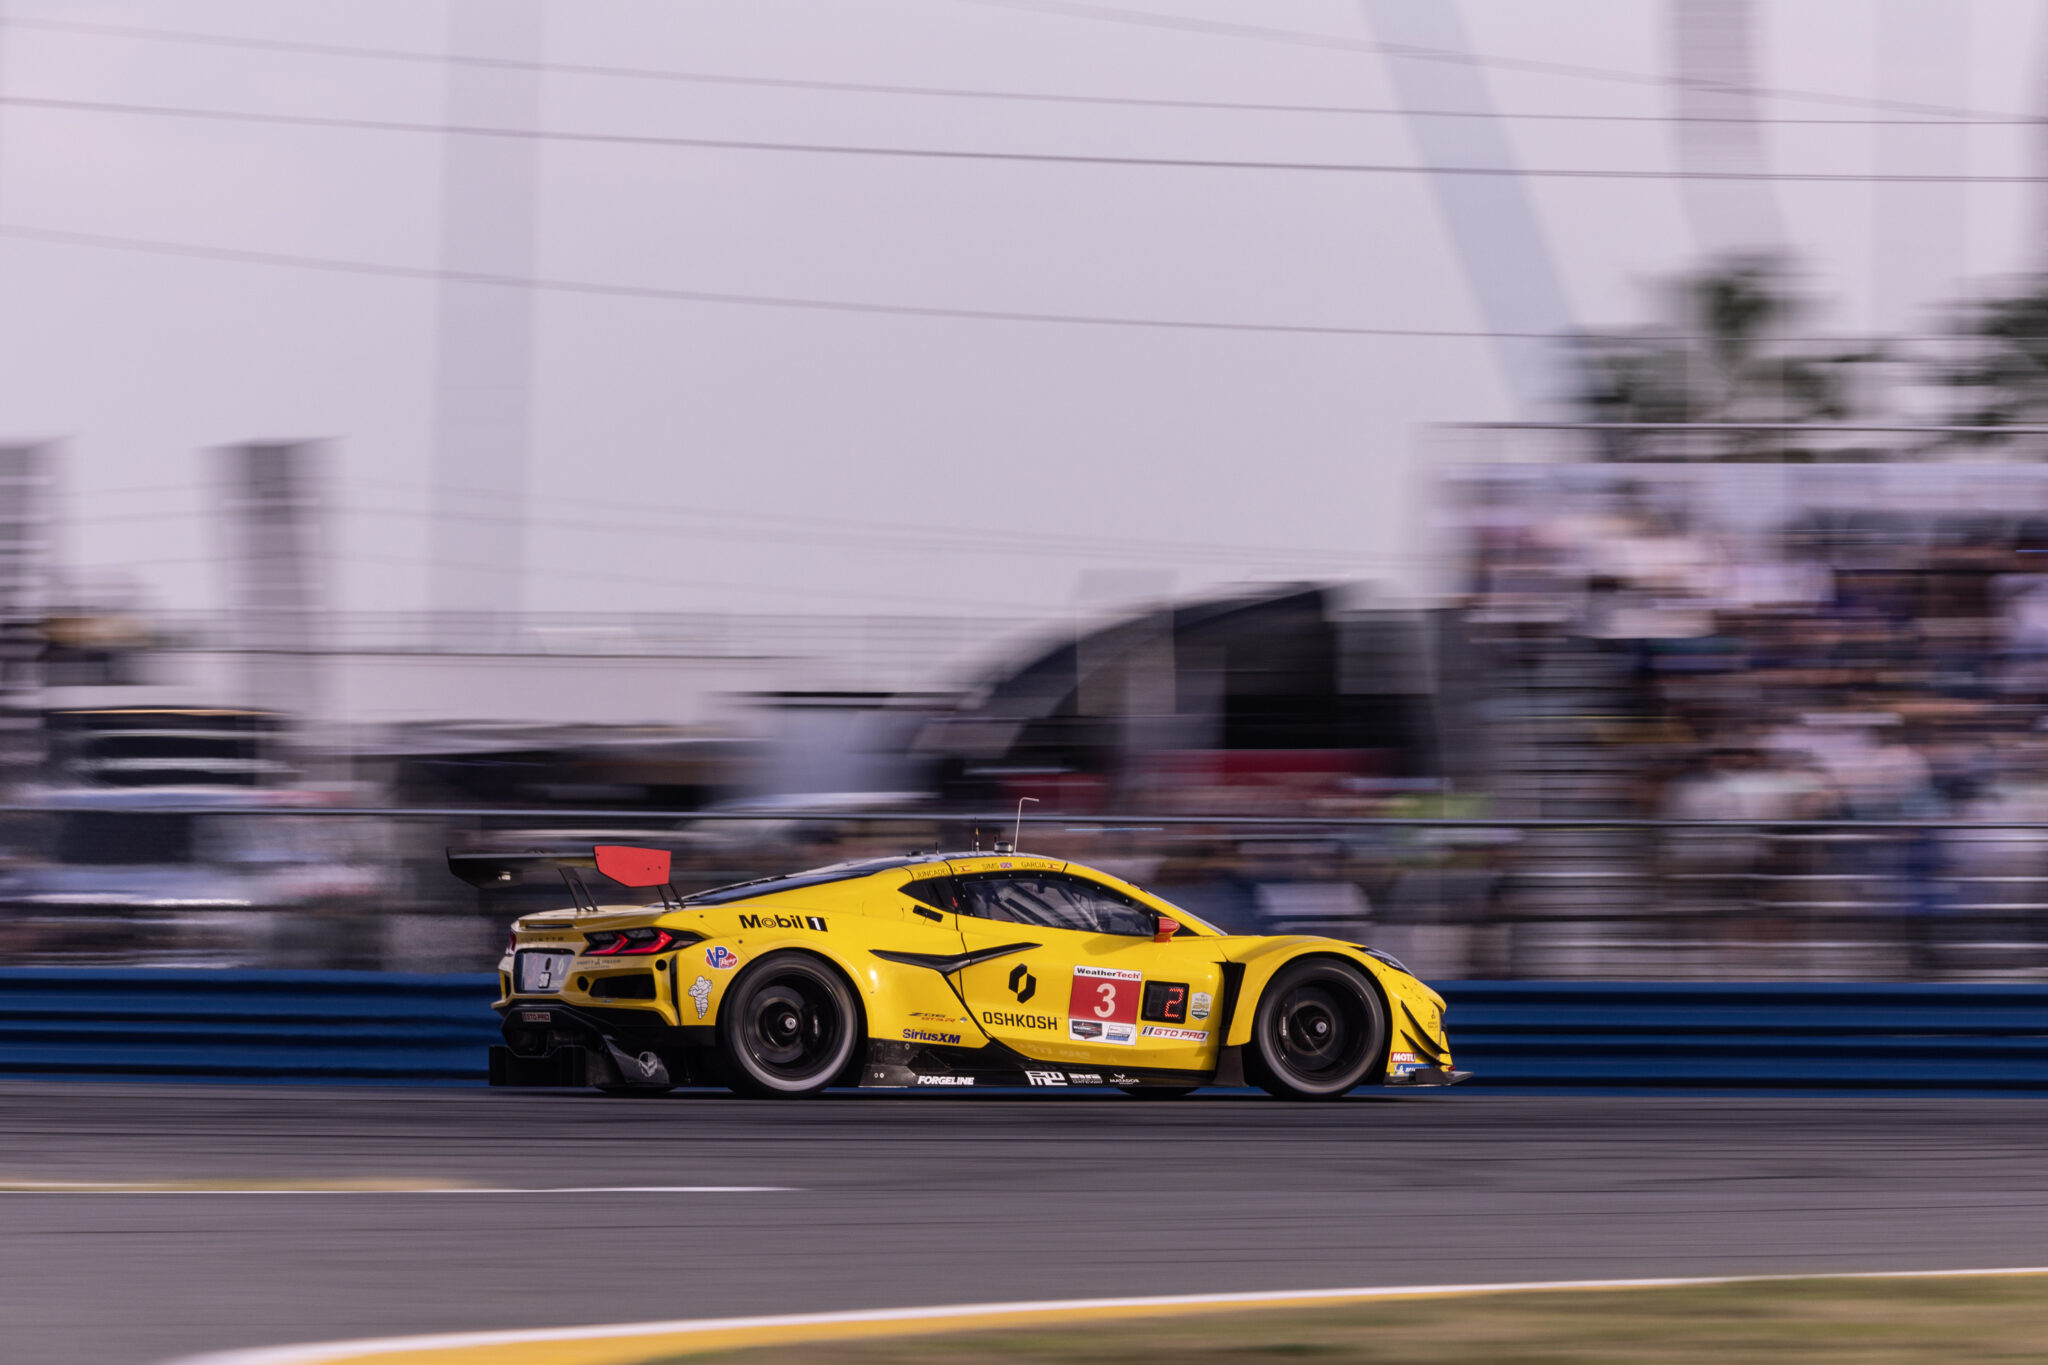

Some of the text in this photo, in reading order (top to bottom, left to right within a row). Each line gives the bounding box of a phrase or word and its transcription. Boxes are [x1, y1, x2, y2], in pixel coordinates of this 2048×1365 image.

[1021, 861, 1046, 869] GARCIA
[739, 915, 824, 931] Mobil 1
[706, 946, 728, 969] VP
[1077, 967, 1140, 979] WeatherTech
[1093, 982, 1117, 1018] 3
[1164, 987, 1184, 1018] 2
[982, 1011, 1058, 1030] OSHKOSH
[902, 1028, 961, 1045] SiriusXM
[1154, 1028, 1206, 1040] GTD PRO
[1393, 1053, 1416, 1062] MOTU
[917, 1075, 975, 1085] FORGELINE
